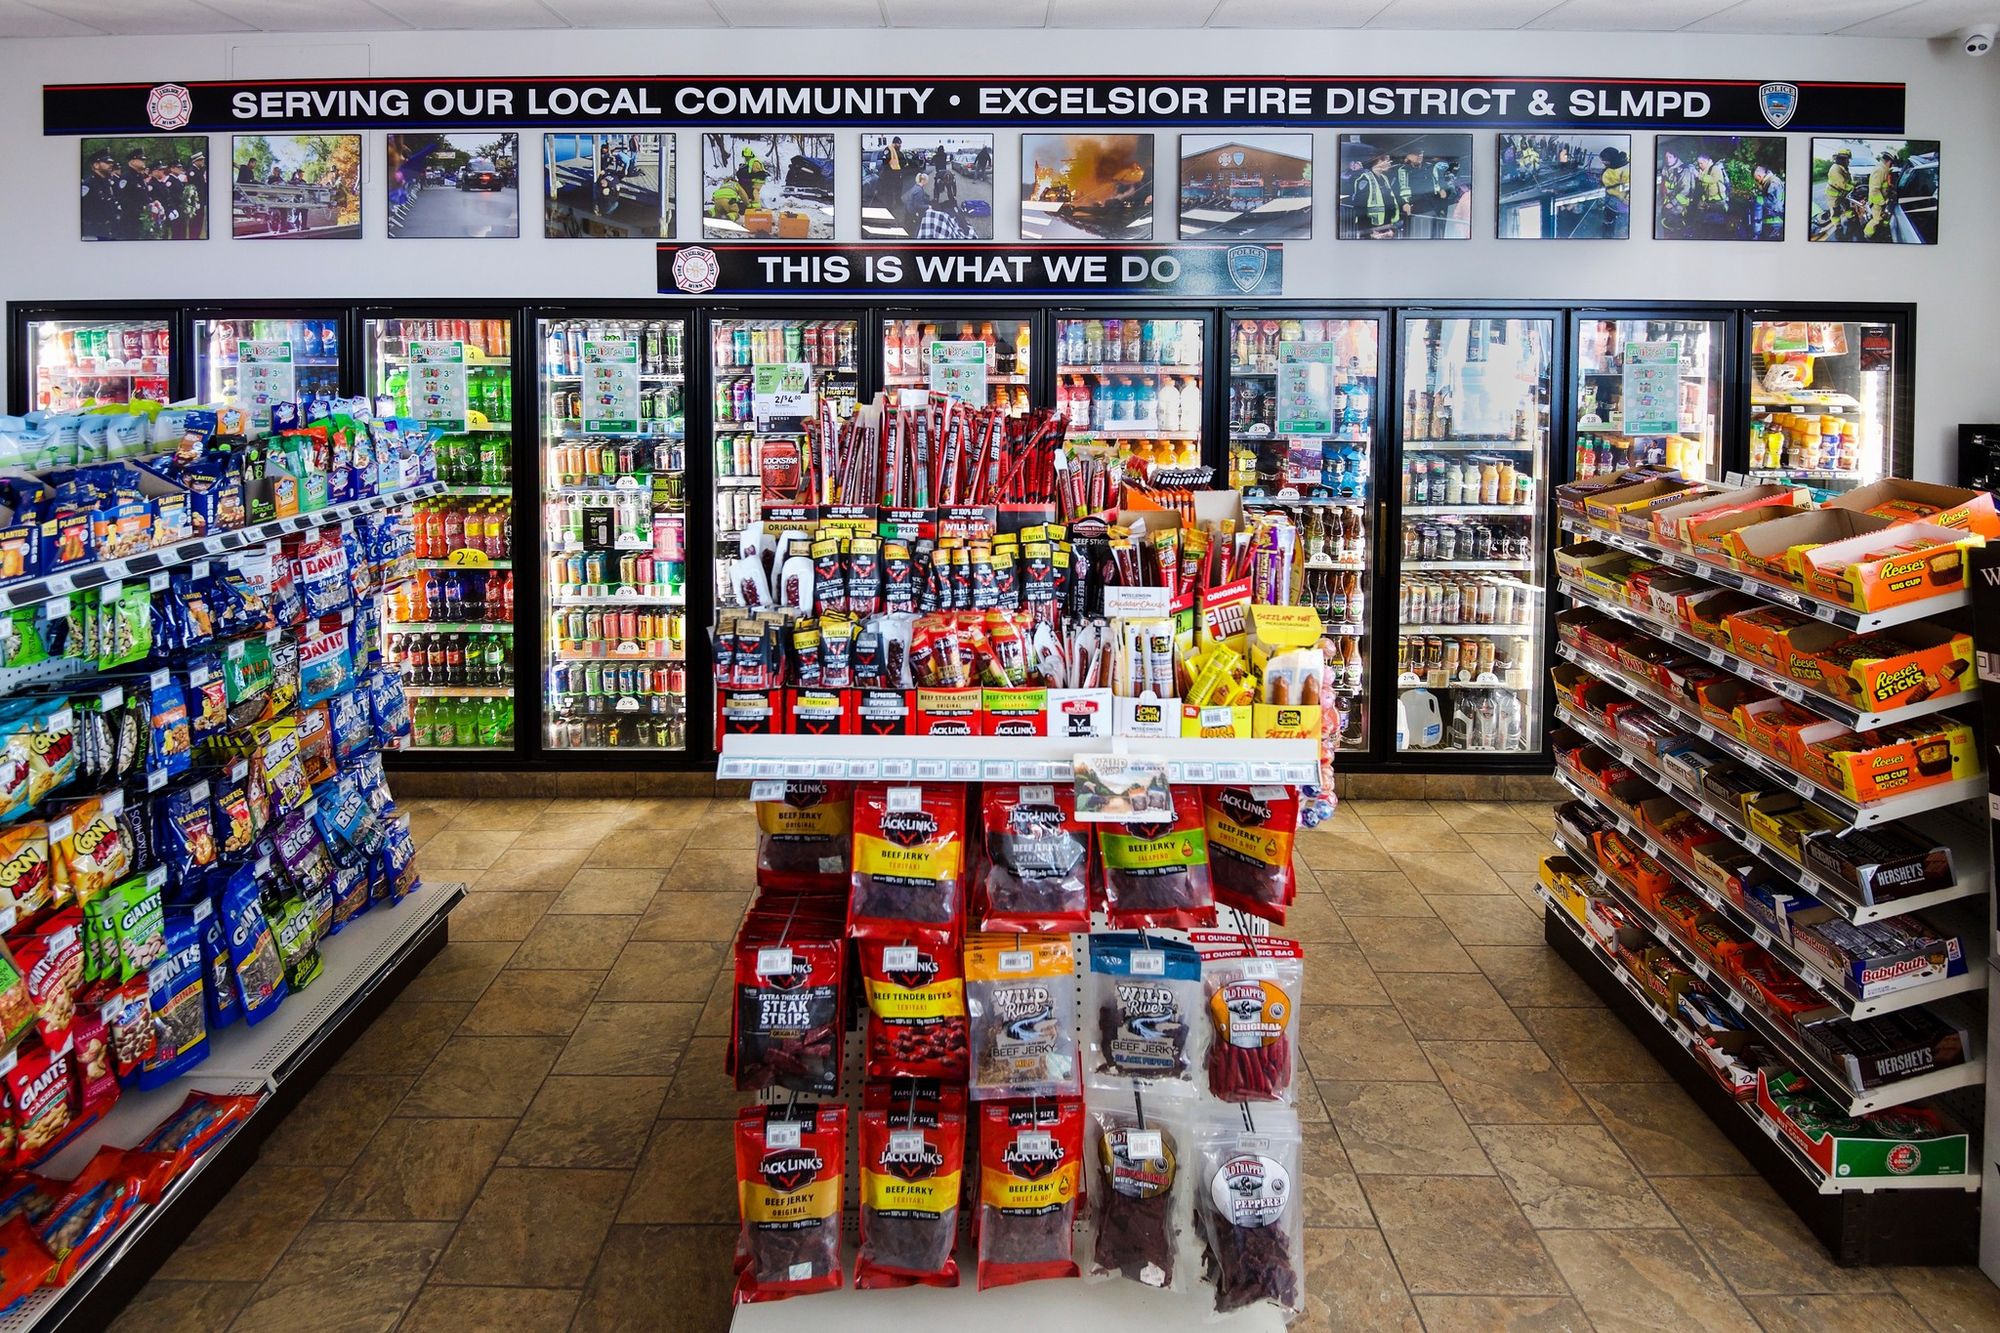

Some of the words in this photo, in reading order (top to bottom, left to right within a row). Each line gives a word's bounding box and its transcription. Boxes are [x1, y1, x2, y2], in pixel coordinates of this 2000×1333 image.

[233, 90, 408, 118] SERVING
[424, 89, 513, 115] OUR
[529, 88, 661, 114] LOCAL
[675, 88, 934, 114] COMMUNITY
[980, 87, 1208, 114] EXCELSIOR
[1224, 88, 1312, 114] FIRE
[1327, 88, 1515, 114] DISTRICT
[1527, 90, 1556, 114] &
[1568, 90, 1711, 117] SLMPD
[758, 256, 850, 282] THIS
[866, 256, 902, 282] IS
[916, 256, 1031, 282] WHAT
[1043, 257, 1106, 281] WE
[1121, 257, 1181, 283] DO
[158, 494, 186, 507] PLANTERS
[59, 515, 88, 529] PLANTERS
[1937, 506, 1971, 526] Reese's
[768, 523, 809, 532] ORIGINAL
[944, 523, 966, 532] WILD
[966, 523, 990, 532] HEAT
[1741, 551, 1765, 567] Reese's
[1880, 558, 1925, 580] Reese's
[1811, 570, 1835, 585] Reese's
[1891, 581, 1905, 591] BIG
[1905, 578, 1921, 588] CUP
[1207, 585, 1248, 602] ORIGINAL
[300, 632, 344, 663] DAVID
[1789, 653, 1818, 670] Reese's
[1791, 667, 1824, 681] STICKS
[1875, 662, 1919, 689] Reese's
[1877, 673, 1924, 701] STICKS
[929, 726, 948, 735] JACK
[948, 726, 971, 735] LINK'S
[995, 726, 1013, 735] JACK
[1013, 726, 1037, 735] LINK'S
[1872, 754, 1905, 769] Reese's
[1874, 773, 1890, 783] BIG
[1890, 769, 1908, 780] CUP
[334, 792, 361, 829] BIGS
[1218, 792, 1243, 810] JACK
[1242, 801, 1272, 819] LINK'S
[176, 807, 208, 826] PLANTERS
[779, 812, 798, 820] BEEF
[798, 812, 823, 820] JERKY
[1008, 810, 1034, 824] JACK
[878, 817, 905, 829] JACK
[905, 818, 938, 832] LINK'S
[73, 818, 111, 855] CORN
[131, 808, 145, 870] PISTACHIOS
[1217, 820, 1237, 837] BEEF
[1236, 827, 1262, 844] JERKY
[281, 822, 316, 860] BIGS
[1012, 843, 1033, 853] BEEF
[1128, 843, 1149, 853] BEEF
[1149, 842, 1176, 852] JERKY
[881, 850, 901, 859] BEEF
[903, 851, 929, 861] JERKY
[0, 847, 40, 888] CORN
[888, 862, 921, 871] TERIYAKI
[1876, 862, 1924, 887] HERSHEY'S
[121, 892, 163, 930] GIANTS
[280, 906, 316, 948] BIGS
[1212, 950, 1242, 959] OUNCE
[162, 984, 199, 1015] ORIGINAL
[759, 993, 780, 1001] EXTRA
[781, 993, 801, 1001] THICK
[800, 990, 814, 1001] CUT
[873, 992, 892, 1000] BEEF
[893, 993, 926, 1001] TENDER
[927, 991, 952, 1000] BITES
[993, 986, 1049, 1004] WILD
[1116, 985, 1174, 1004] WILD
[1223, 989, 1237, 999] OLD
[1236, 986, 1266, 1000] TRAPPER
[762, 1000, 808, 1013] STEAK
[1005, 1002, 1044, 1020] River
[1127, 1001, 1166, 1015] River
[760, 1012, 811, 1026] STRIPS
[772, 1030, 800, 1038] ORIGINAL
[1232, 1023, 1282, 1031] ORIGINAL
[992, 1046, 1020, 1058] BEEF
[1021, 1042, 1057, 1057] JERKY
[1112, 1041, 1140, 1051] BEEF
[1141, 1042, 1176, 1055] JERKY
[1014, 1059, 1036, 1068] MILD
[1115, 1054, 1143, 1064] BLACK
[1142, 1057, 1174, 1067] PEPPER
[1876, 1047, 1933, 1076] HERSHEY'S
[20, 1057, 68, 1110] GIANTS
[878, 1151, 908, 1164] JACK
[908, 1152, 944, 1165] LINK'S
[1001, 1150, 1027, 1164] JACK
[759, 1163, 788, 1174] JACK
[787, 1157, 823, 1170] LINK'S
[1222, 1162, 1237, 1177] OLD
[1236, 1161, 1266, 1175] TRAPPER
[885, 1186, 906, 1195] BEEF
[906, 1186, 934, 1196] JERKY
[1008, 1184, 1029, 1193] BEEF
[1029, 1182, 1056, 1193] JERKY
[1114, 1177, 1135, 1186] BEEF
[1135, 1179, 1159, 1191] JERKY
[764, 1197, 786, 1206] BEEF
[786, 1194, 815, 1206] JERKY
[1235, 1197, 1286, 1209] PEPPERED
[772, 1206, 807, 1217] ORIGINAL
[1255, 1208, 1279, 1216] JERKY
